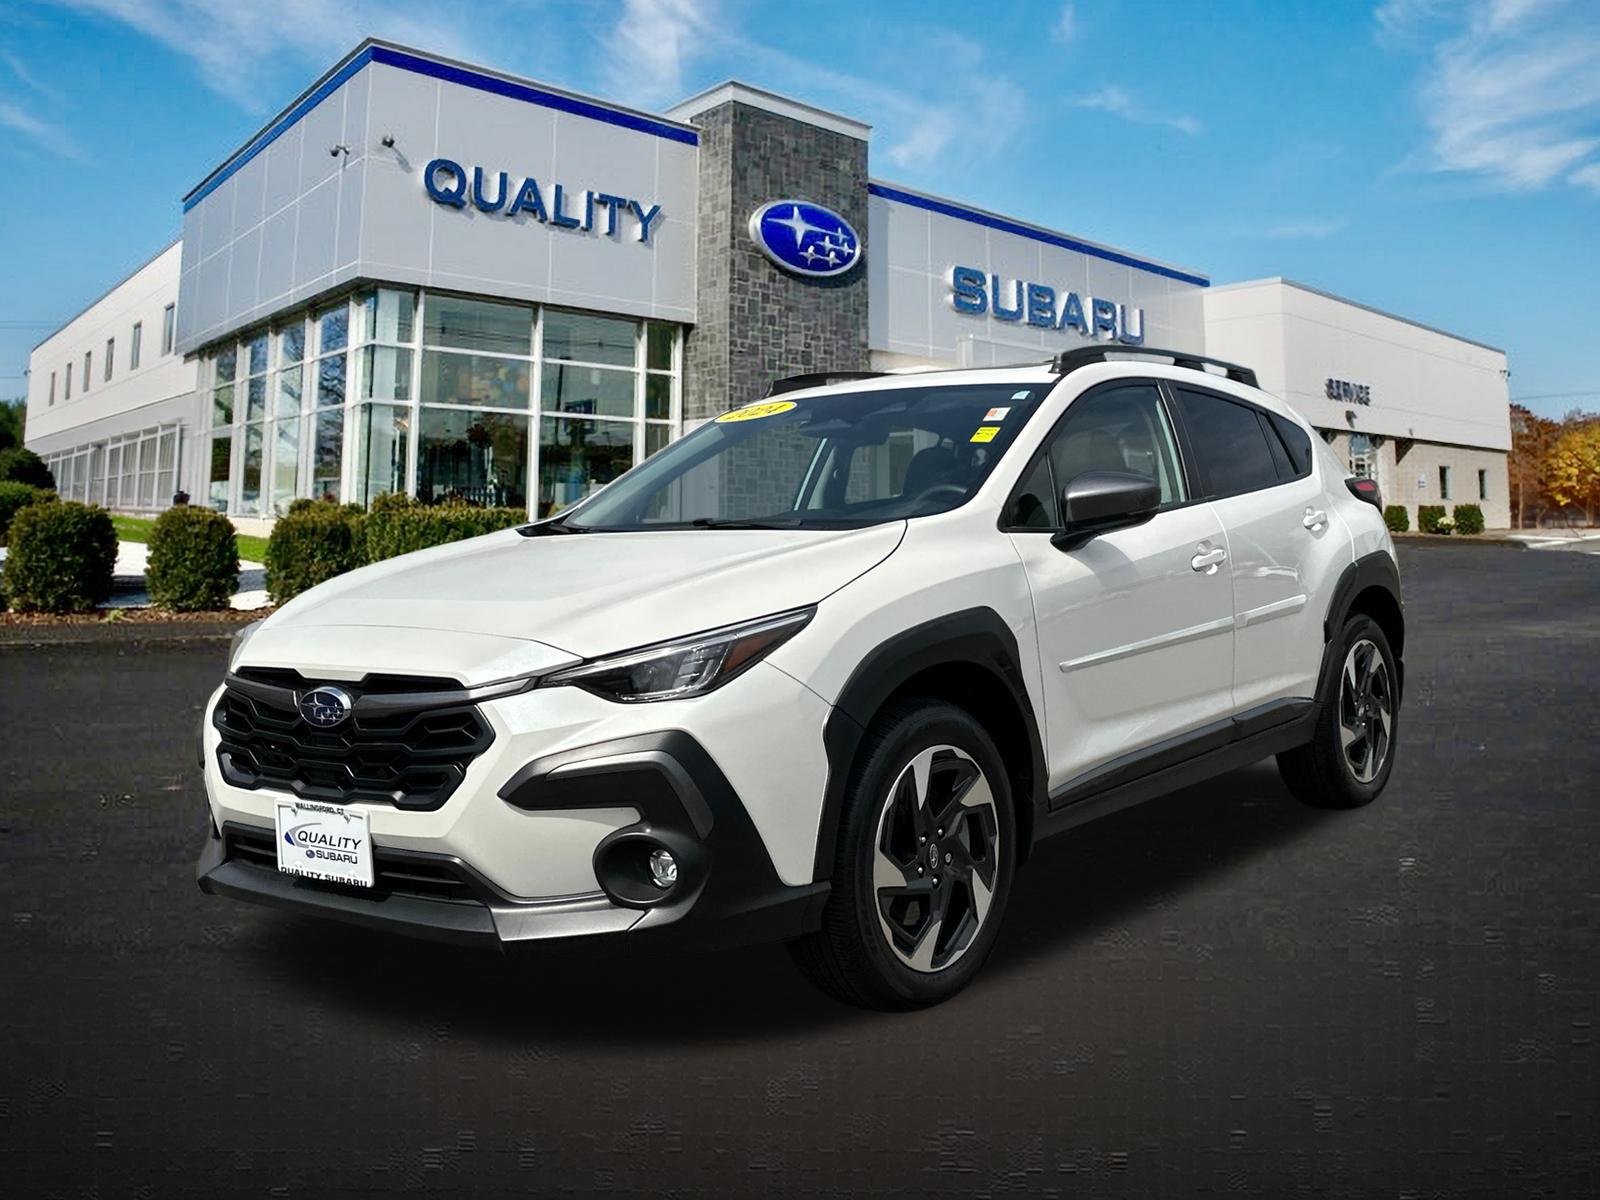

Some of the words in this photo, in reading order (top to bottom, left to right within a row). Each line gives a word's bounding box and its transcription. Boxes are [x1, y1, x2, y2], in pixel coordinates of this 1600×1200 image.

[424, 158, 661, 242] QUALITY
[949, 265, 1144, 345] SUBARU
[297, 830, 362, 850] QUALITY
[315, 849, 358, 865] SUBARU
[280, 866, 321, 880] QUALITY
[324, 874, 368, 887] SUBARU
